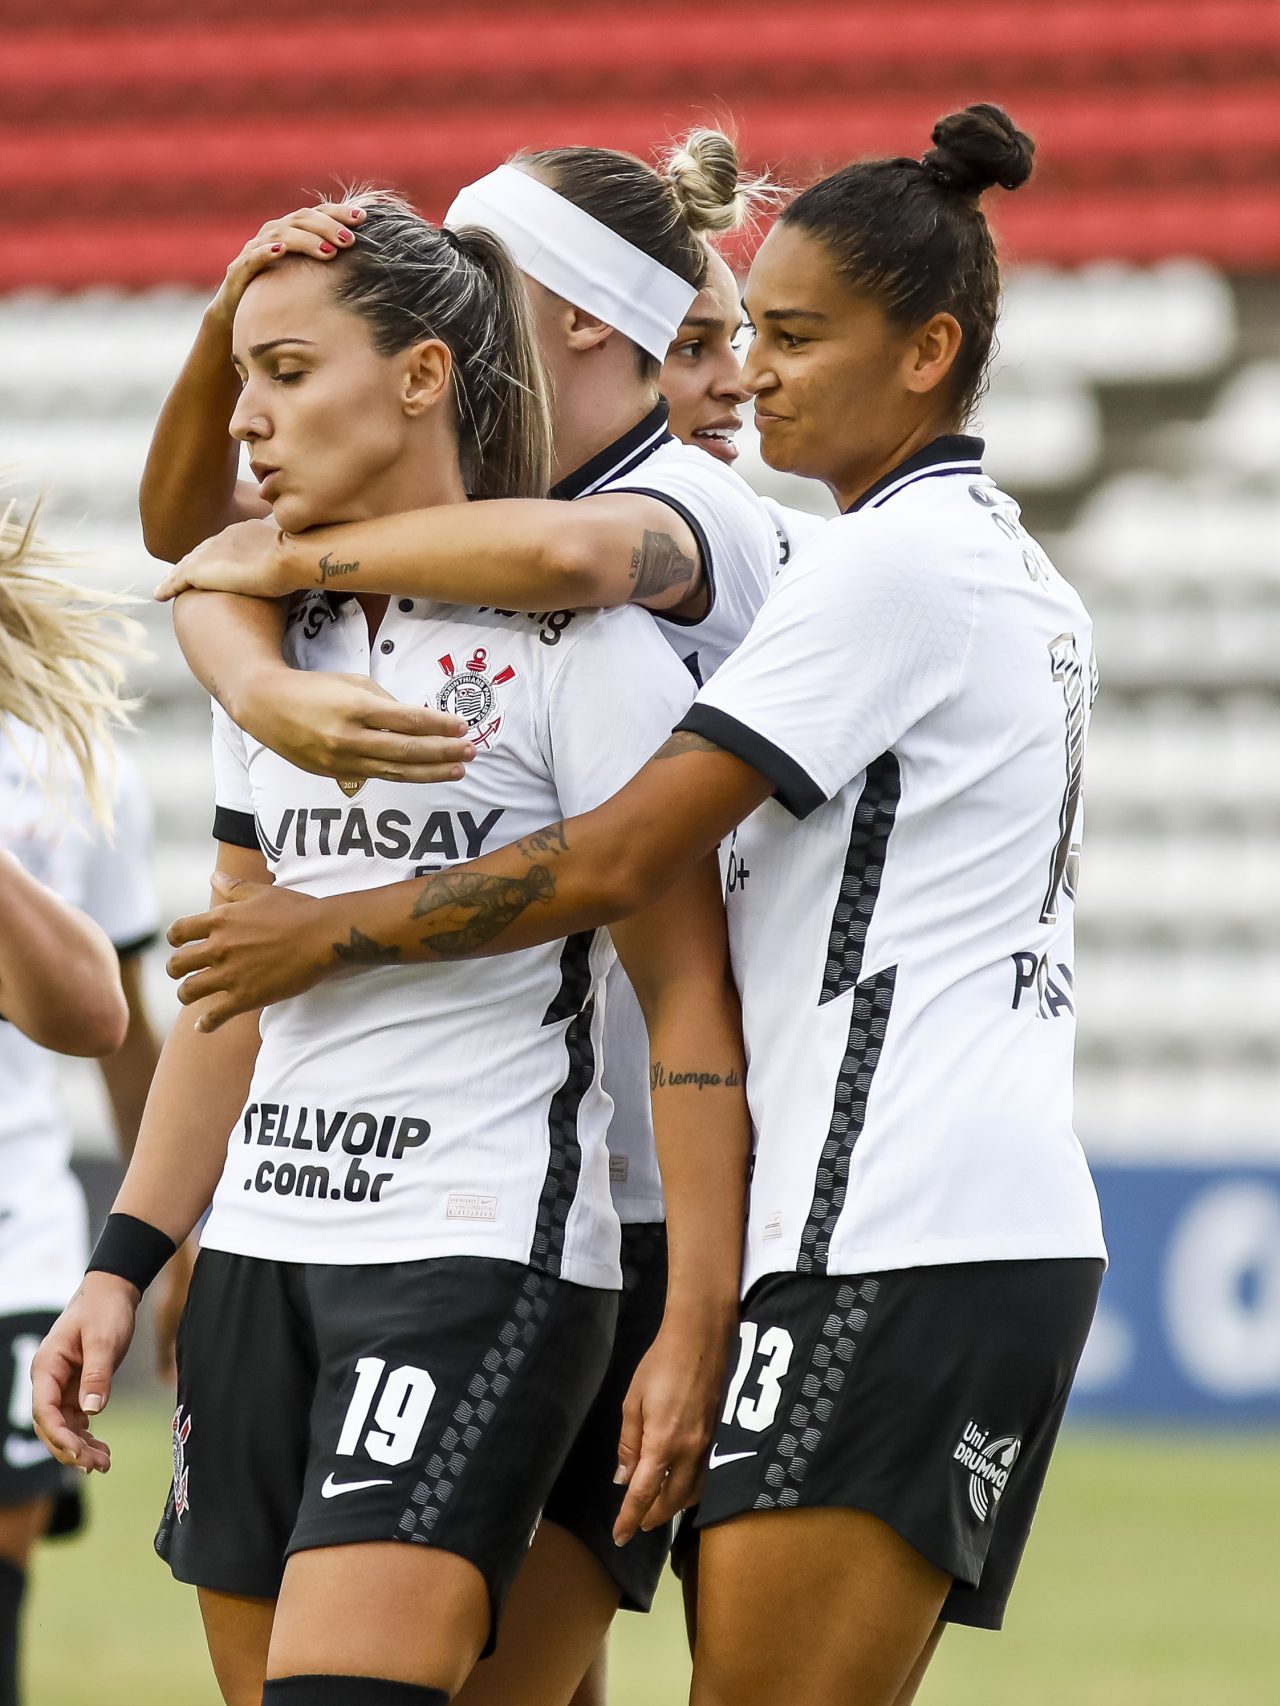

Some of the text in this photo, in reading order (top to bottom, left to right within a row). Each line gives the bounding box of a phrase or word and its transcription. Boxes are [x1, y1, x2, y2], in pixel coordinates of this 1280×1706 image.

[315, 552, 360, 584] Jaime
[442, 676, 485, 701] CORINTHIANS
[254, 808, 506, 863] VITASAY
[669, 1071, 721, 1091] tempo
[243, 1103, 432, 1160] TELLVOIP
[243, 1157, 395, 1203] .com.br
[721, 1321, 794, 1433] 13
[335, 1356, 437, 1467] 19
[963, 1421, 989, 1450] Uni
